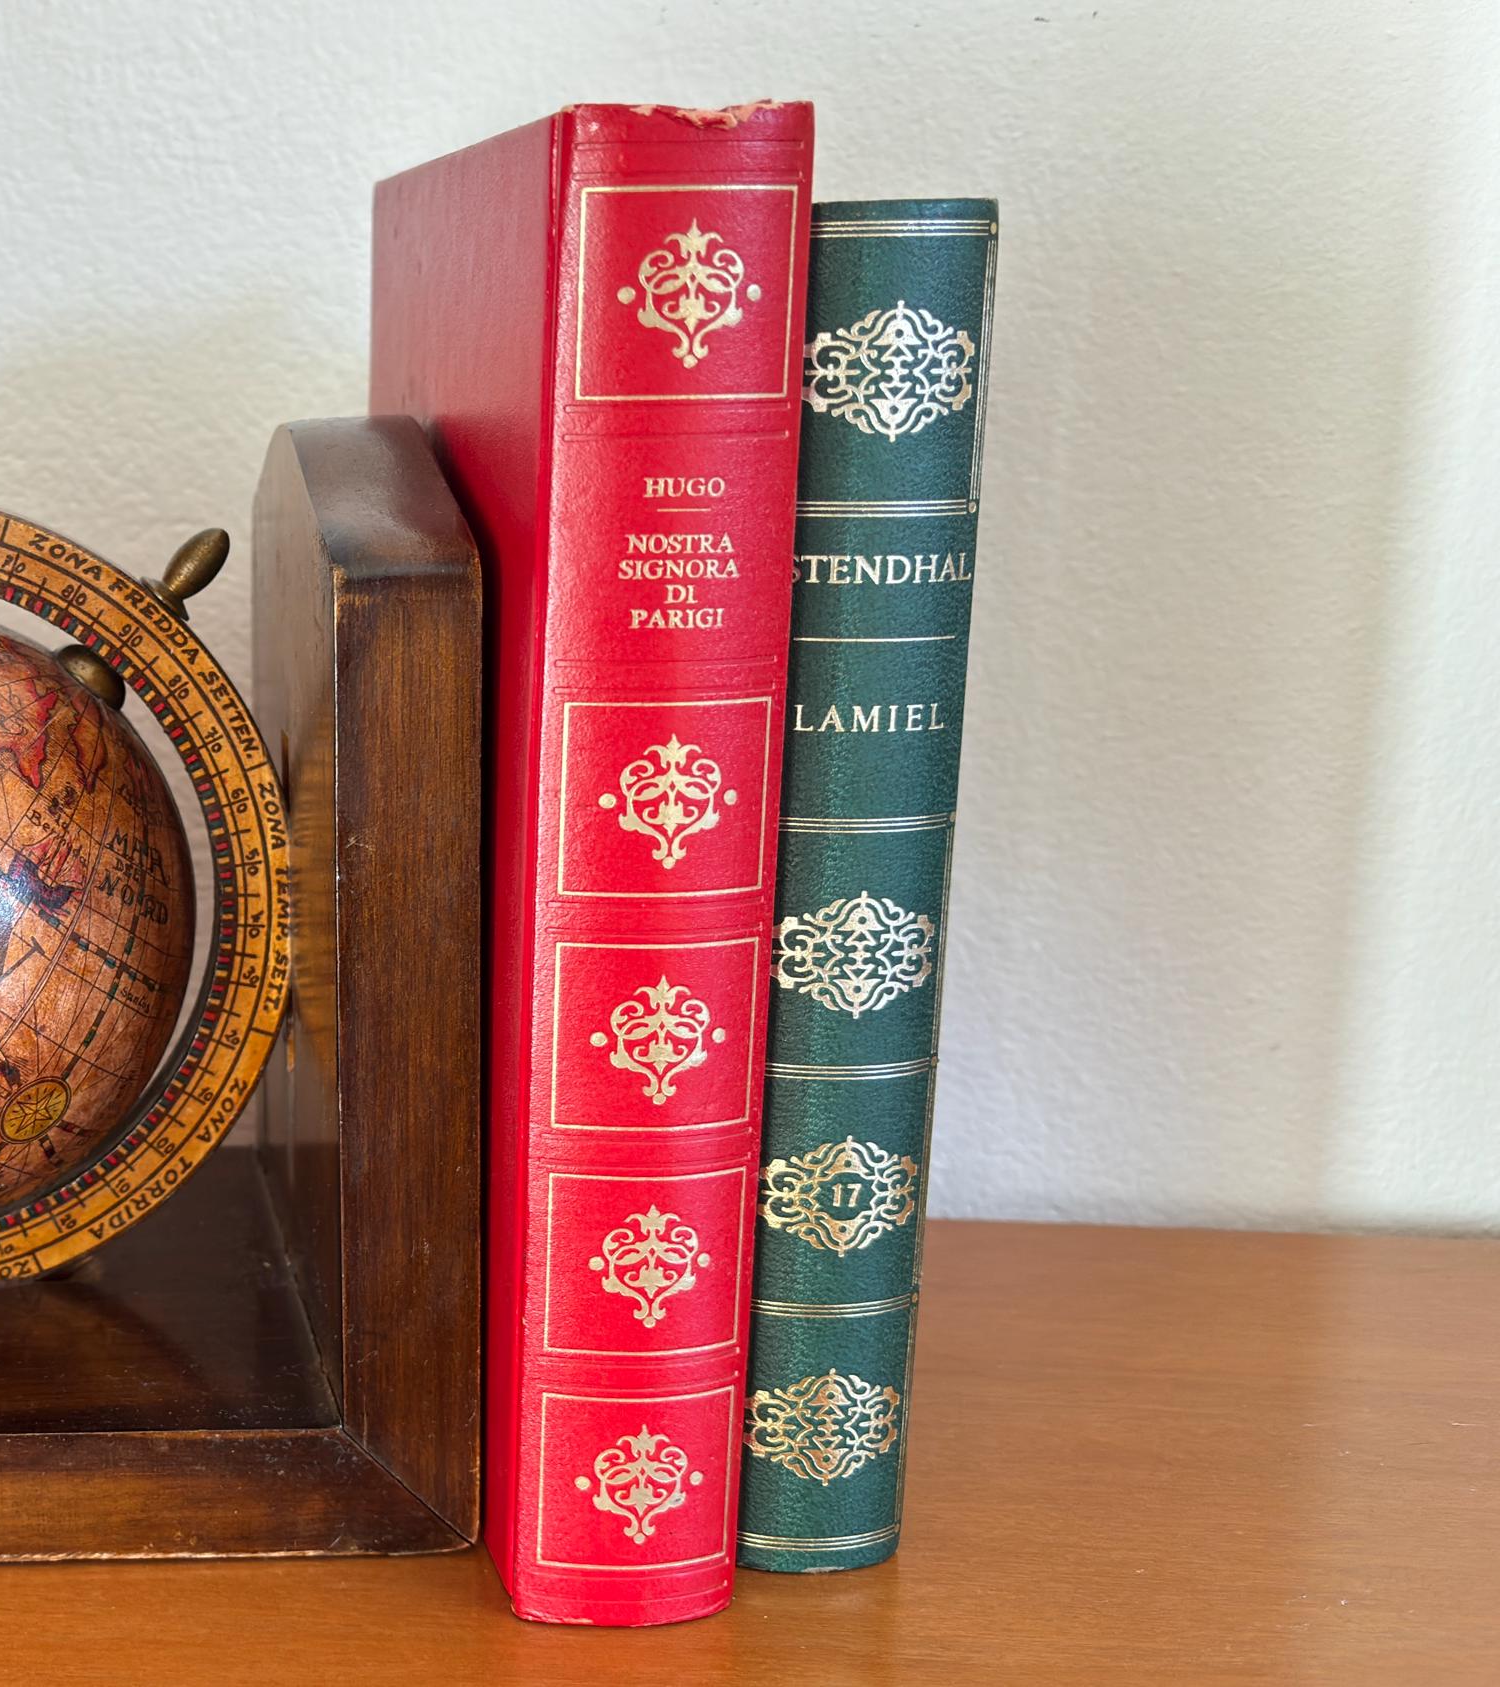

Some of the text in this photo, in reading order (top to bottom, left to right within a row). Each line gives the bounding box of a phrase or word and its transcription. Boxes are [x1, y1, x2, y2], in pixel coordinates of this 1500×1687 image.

[643, 477, 726, 499] HUGO
[626, 533, 735, 555] NOSTRA
[618, 559, 739, 581] SIGNORA
[792, 554, 971, 585] STENDHAL
[664, 584, 698, 605] DI
[629, 607, 724, 630] PARIGI
[27, 531, 107, 582] ZONA
[107, 575, 204, 666] FREDDA
[197, 664, 262, 760] SETTEN.
[793, 703, 944, 733] LAMIEL
[258, 782, 287, 850] ZONA
[263, 951, 288, 1011] SETT.
[86, 1076, 248, 1242] ZONA TORRIDA
[831, 1183, 862, 1207] 17
